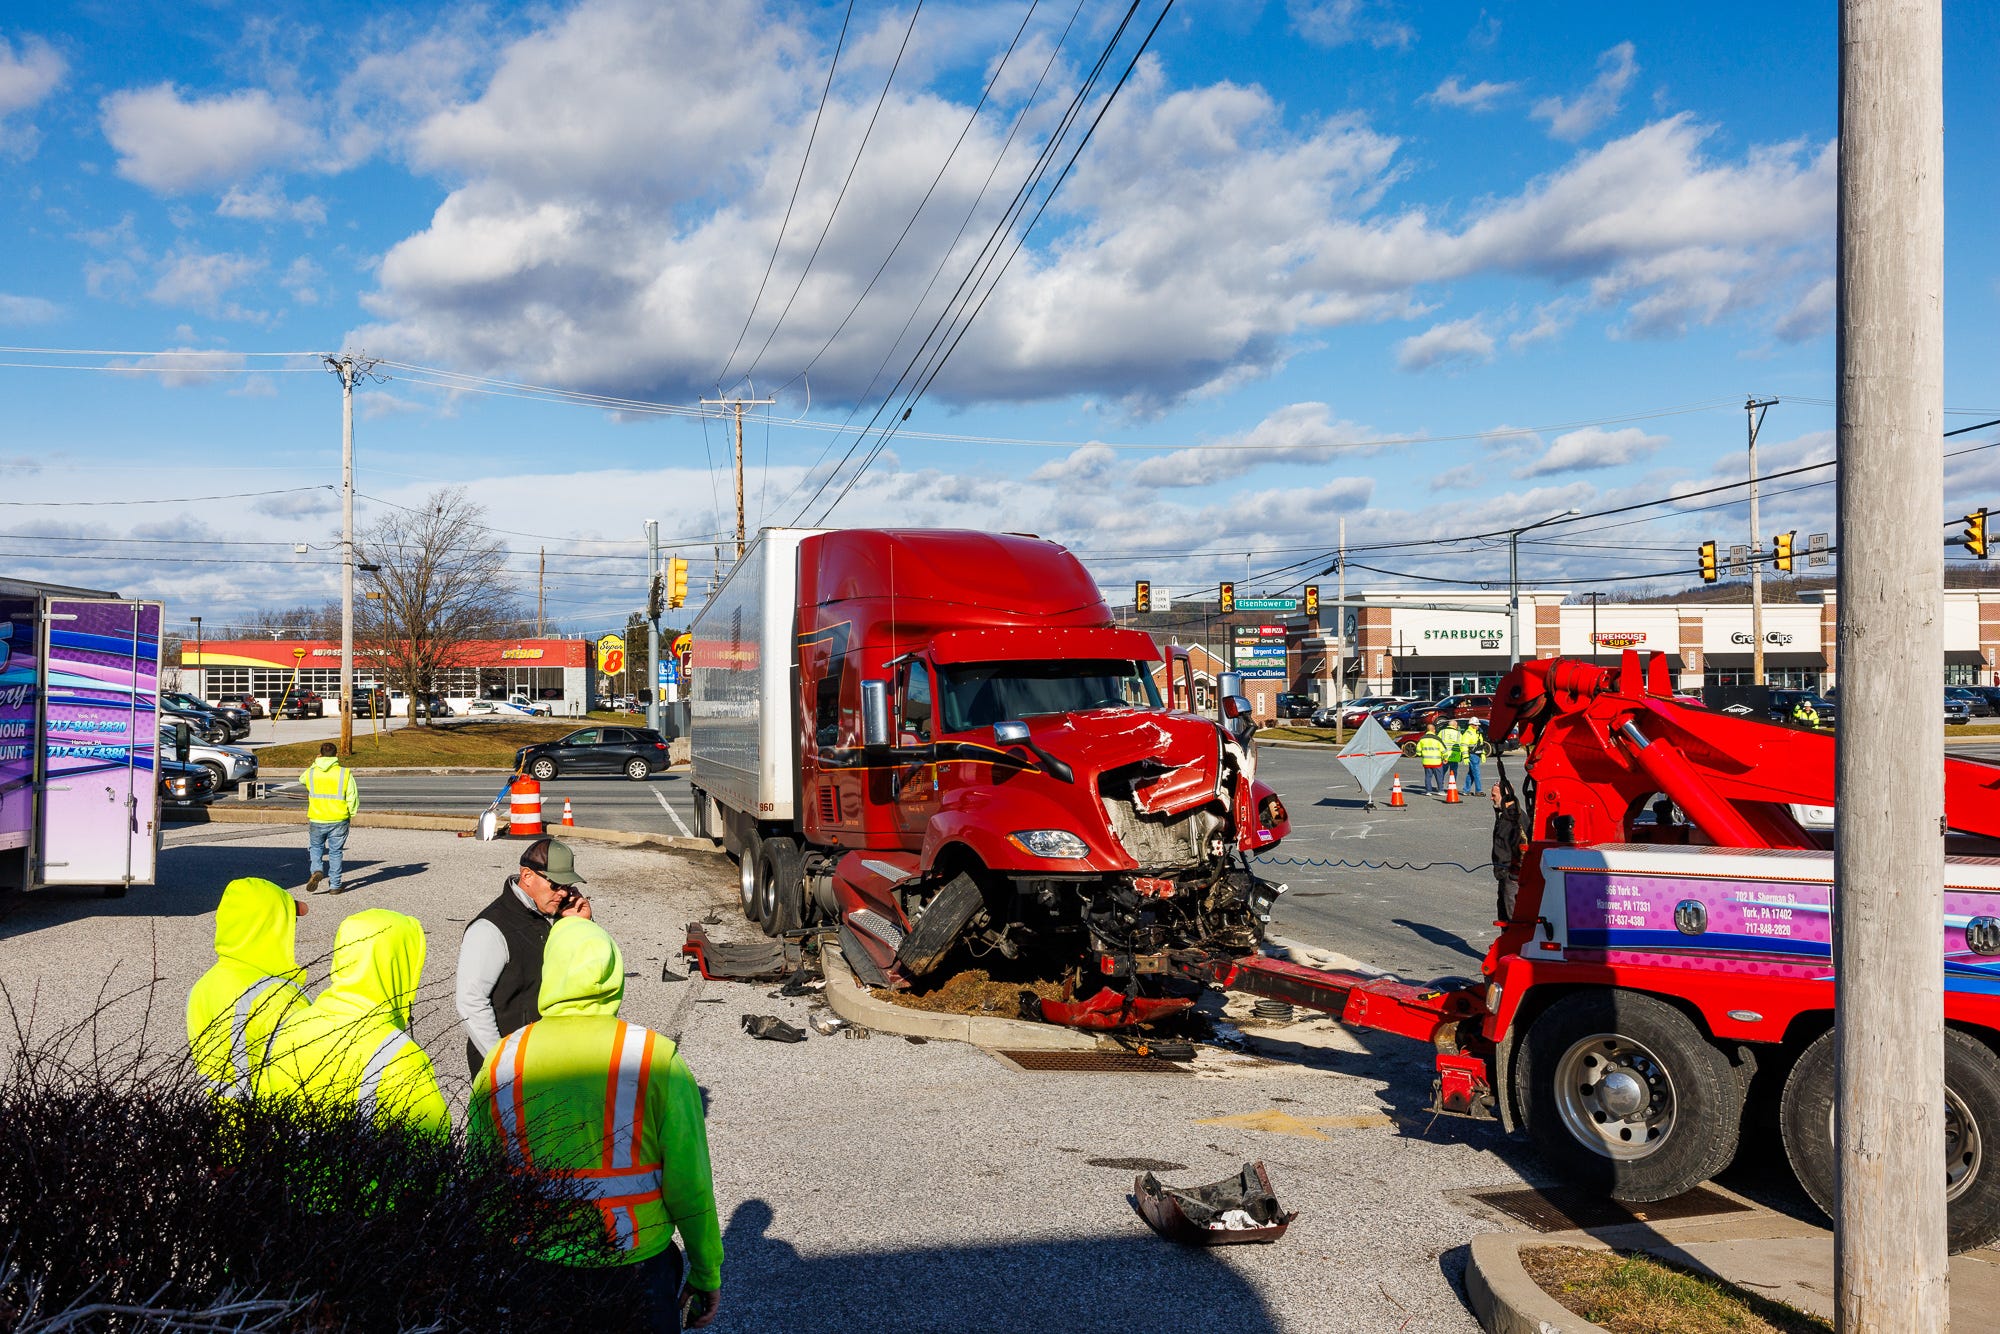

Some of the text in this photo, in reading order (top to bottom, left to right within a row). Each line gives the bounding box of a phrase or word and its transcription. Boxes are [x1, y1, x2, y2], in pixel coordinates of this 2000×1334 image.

[1733, 547, 1743, 555] LEFT
[1811, 556, 1827, 564] SIGNAL
[1731, 566, 1747, 574] SIGNAL
[1424, 629, 1504, 640] STARBUCKS
[1592, 633, 1645, 641] FIREHOUSE
[1731, 631, 1793, 646] Gre Clips
[600, 640, 624, 656] Super
[603, 650, 624, 673] 8
[1257, 669, 1286, 677] Collision
[48, 719, 127, 733] 717-848-2820
[48, 746, 126, 759] 717-637-4380
[759, 802, 774, 812] 960
[1617, 885, 1631, 896] York
[1632, 886, 1641, 896] St.
[1736, 891, 1747, 902] 702
[1757, 892, 1787, 903] Sherman
[1596, 899, 1650, 912] Hanover, PA 17331
[1742, 906, 1793, 920] York, PA 17402
[1604, 914, 1645, 927] 717-637-4380
[1745, 922, 1791, 936] 717-848-2820
